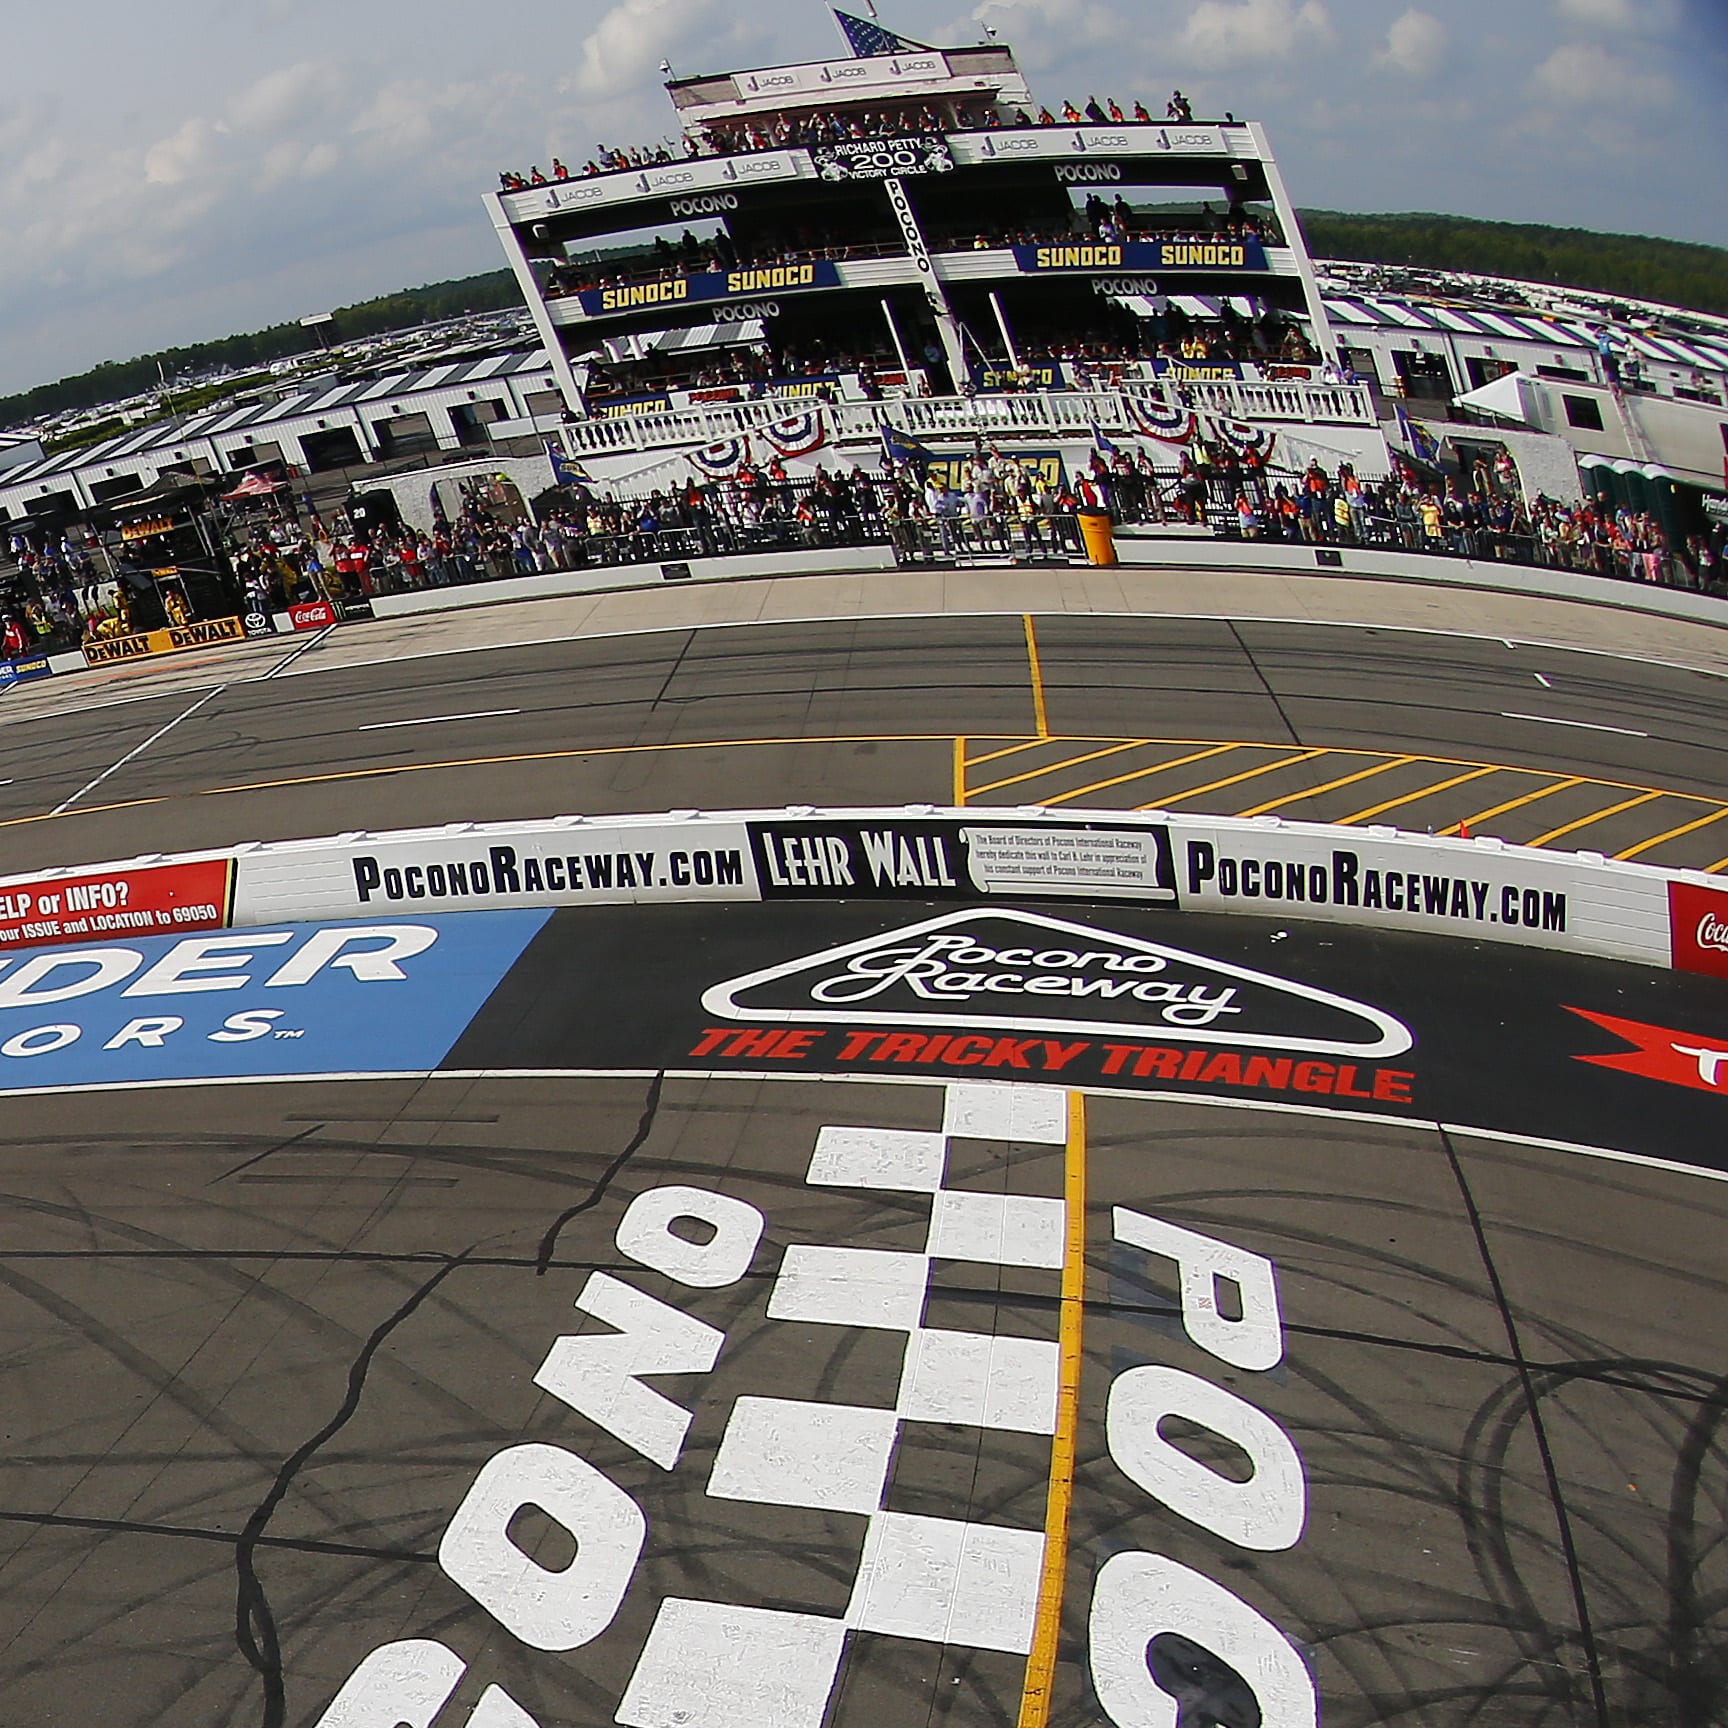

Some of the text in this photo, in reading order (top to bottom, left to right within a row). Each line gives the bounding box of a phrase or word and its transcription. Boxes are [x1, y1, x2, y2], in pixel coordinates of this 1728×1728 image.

[834, 137, 922, 156] RICHARD PETTY
[996, 138, 1039, 151] JACOB
[1086, 134, 1128, 147] JACOB
[1171, 133, 1213, 146] JACOB
[738, 160, 782, 174] JACOB
[850, 150, 916, 170] 200
[651, 172, 694, 187] JACOB
[848, 164, 928, 180] VICTORY CIRCLE
[1054, 163, 1121, 182] POCONO
[561, 187, 604, 202] JACOB
[670, 193, 739, 217] POCONO
[887, 180, 930, 274] POCONO
[1037, 245, 1123, 268] SUNOCO
[1161, 245, 1245, 266] SUNOCO
[727, 264, 814, 293] SUNOCO
[1091, 277, 1158, 296] POCONO
[602, 279, 687, 310] SUNOCO
[712, 301, 780, 323] POCONO
[171, 620, 239, 648] DEWALT
[247, 625, 273, 637] TOYOTA
[86, 636, 150, 663] DEWALT
[16, 659, 47, 674] SUNOCO
[761, 829, 956, 888] LEHR WALL
[352, 845, 744, 902] POCONORACEWAY.COM
[39, 894, 62, 914] or
[65, 880, 130, 912] INFO?
[1186, 839, 1567, 933] POCONORACEWAY.COM
[21, 919, 61, 940] ISSUE
[63, 915, 88, 935] and
[90, 909, 154, 933] LOCATION
[155, 908, 171, 926] to
[172, 903, 218, 924] 69050
[847, 934, 1168, 977] Pocono
[811, 952, 1241, 1025] Raceway
[688, 1027, 1415, 1104] THE TRICKY TRIANGLE
